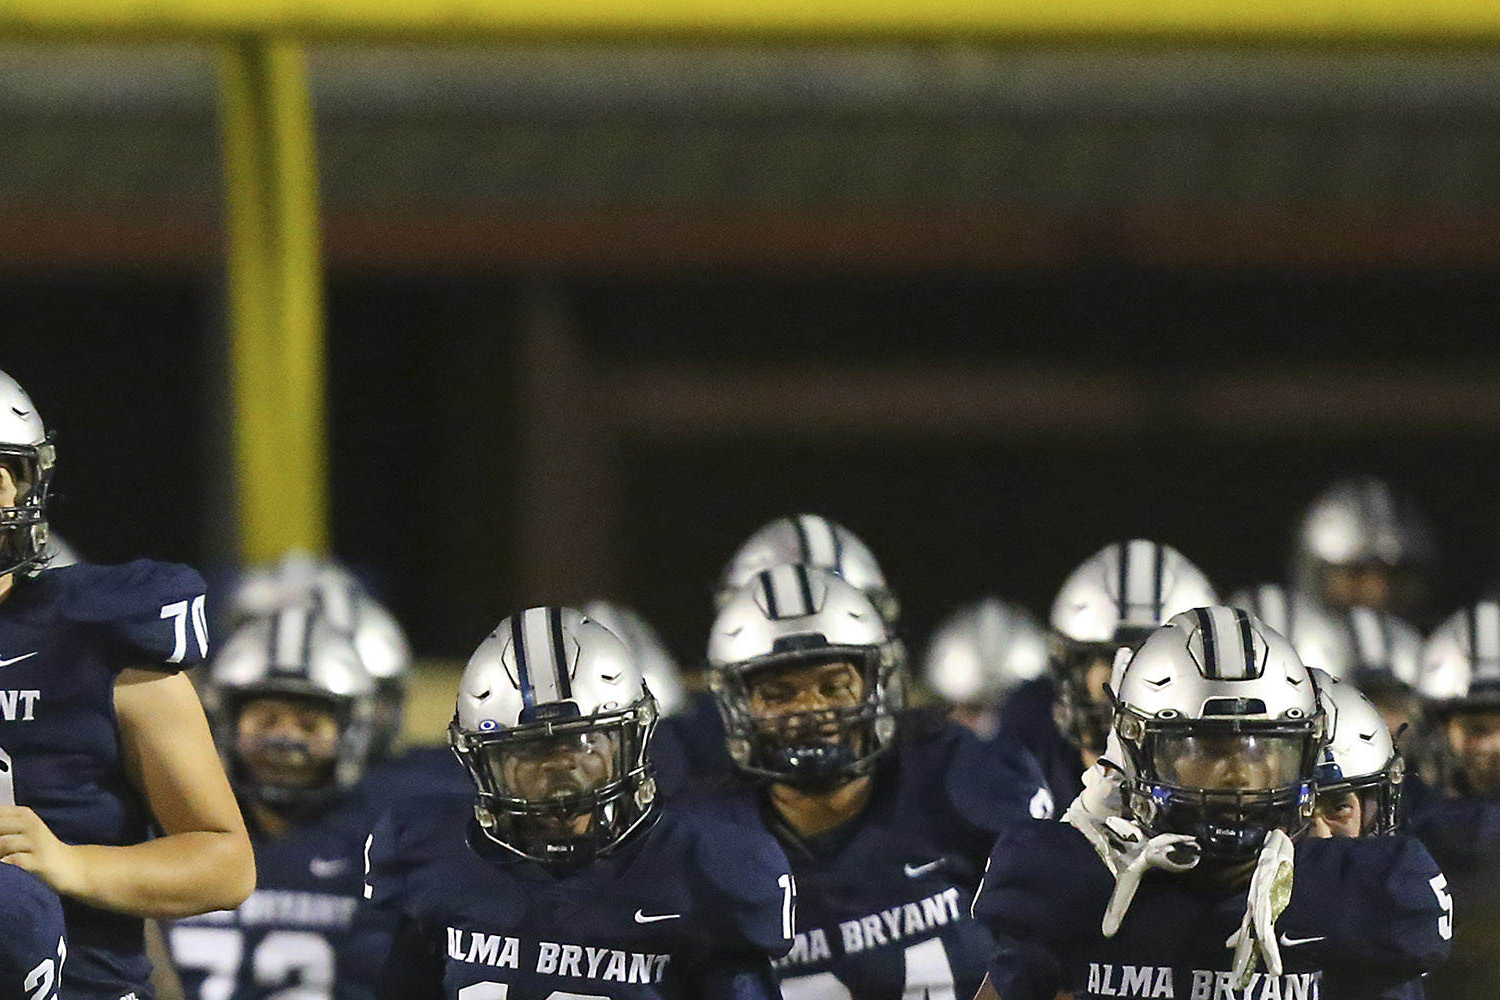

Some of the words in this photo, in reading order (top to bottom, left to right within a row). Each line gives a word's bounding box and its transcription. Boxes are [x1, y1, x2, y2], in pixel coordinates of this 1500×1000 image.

[160, 594, 209, 663] 70
[777, 873, 798, 940] 1
[839, 886, 960, 954] BRYANT
[536, 941, 670, 984] BRYANT
[1087, 962, 1175, 999] ALMA
